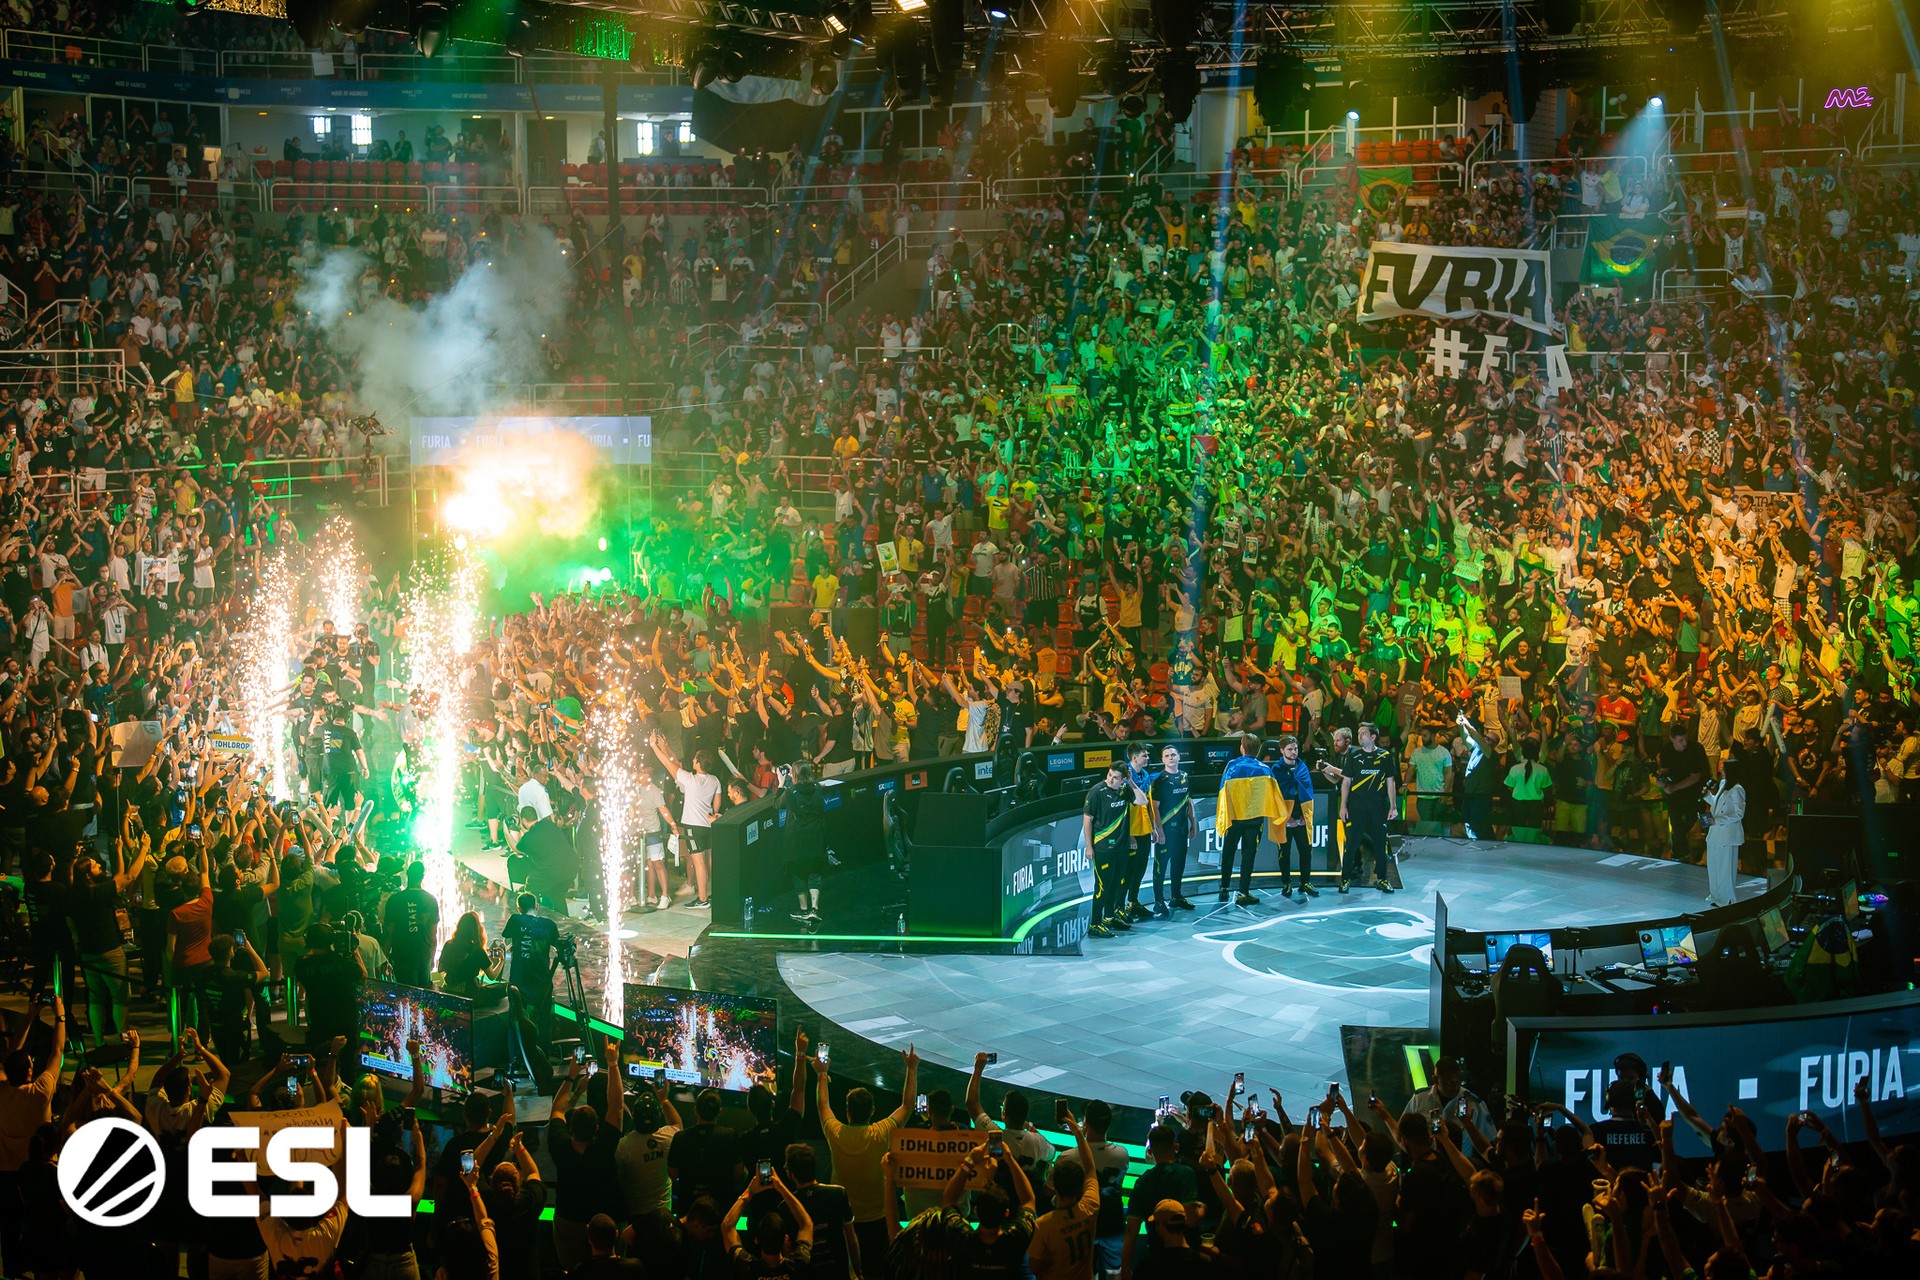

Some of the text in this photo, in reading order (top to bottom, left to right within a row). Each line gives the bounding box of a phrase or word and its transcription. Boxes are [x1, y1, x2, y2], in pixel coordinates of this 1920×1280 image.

[421, 434, 451, 449] FURIA
[215, 740, 250, 750] !DHLDROP
[324, 729, 332, 754] STAFF
[1050, 758, 1073, 766] LEGION
[977, 764, 993, 776] inte
[878, 781, 894, 790] 1XBET
[1013, 847, 1090, 896] FURIA FURIA
[408, 902, 418, 933] STAFF
[1801, 1046, 1904, 1111] FURIA
[1606, 1132, 1646, 1146] REFEREE
[899, 1166, 978, 1181] !DHLDRP
